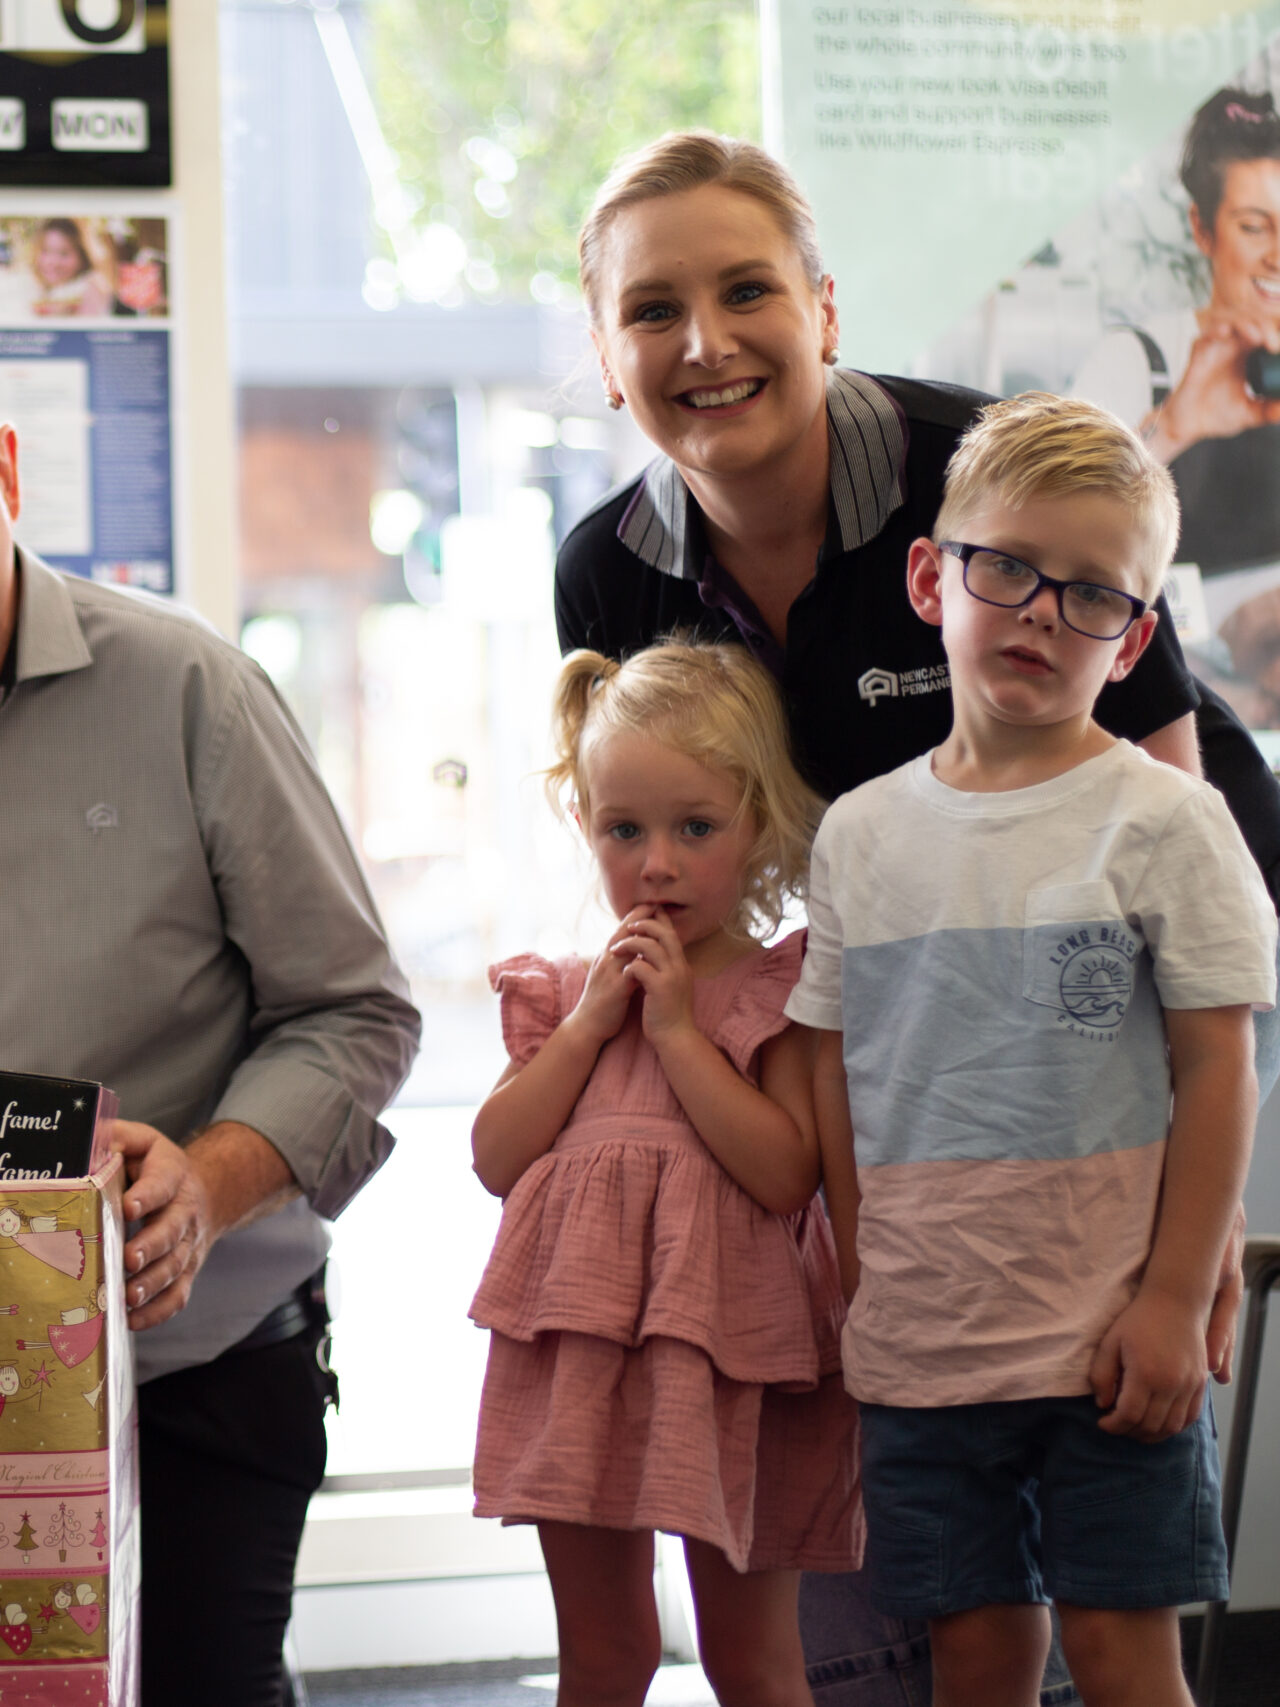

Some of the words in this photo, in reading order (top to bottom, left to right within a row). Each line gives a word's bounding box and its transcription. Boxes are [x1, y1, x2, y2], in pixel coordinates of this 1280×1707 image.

[54, 112, 138, 139] MON
[1049, 929, 1090, 966] LONG
[1100, 927, 1136, 957] BEAC
[1057, 1014, 1120, 1042] CALIFO
